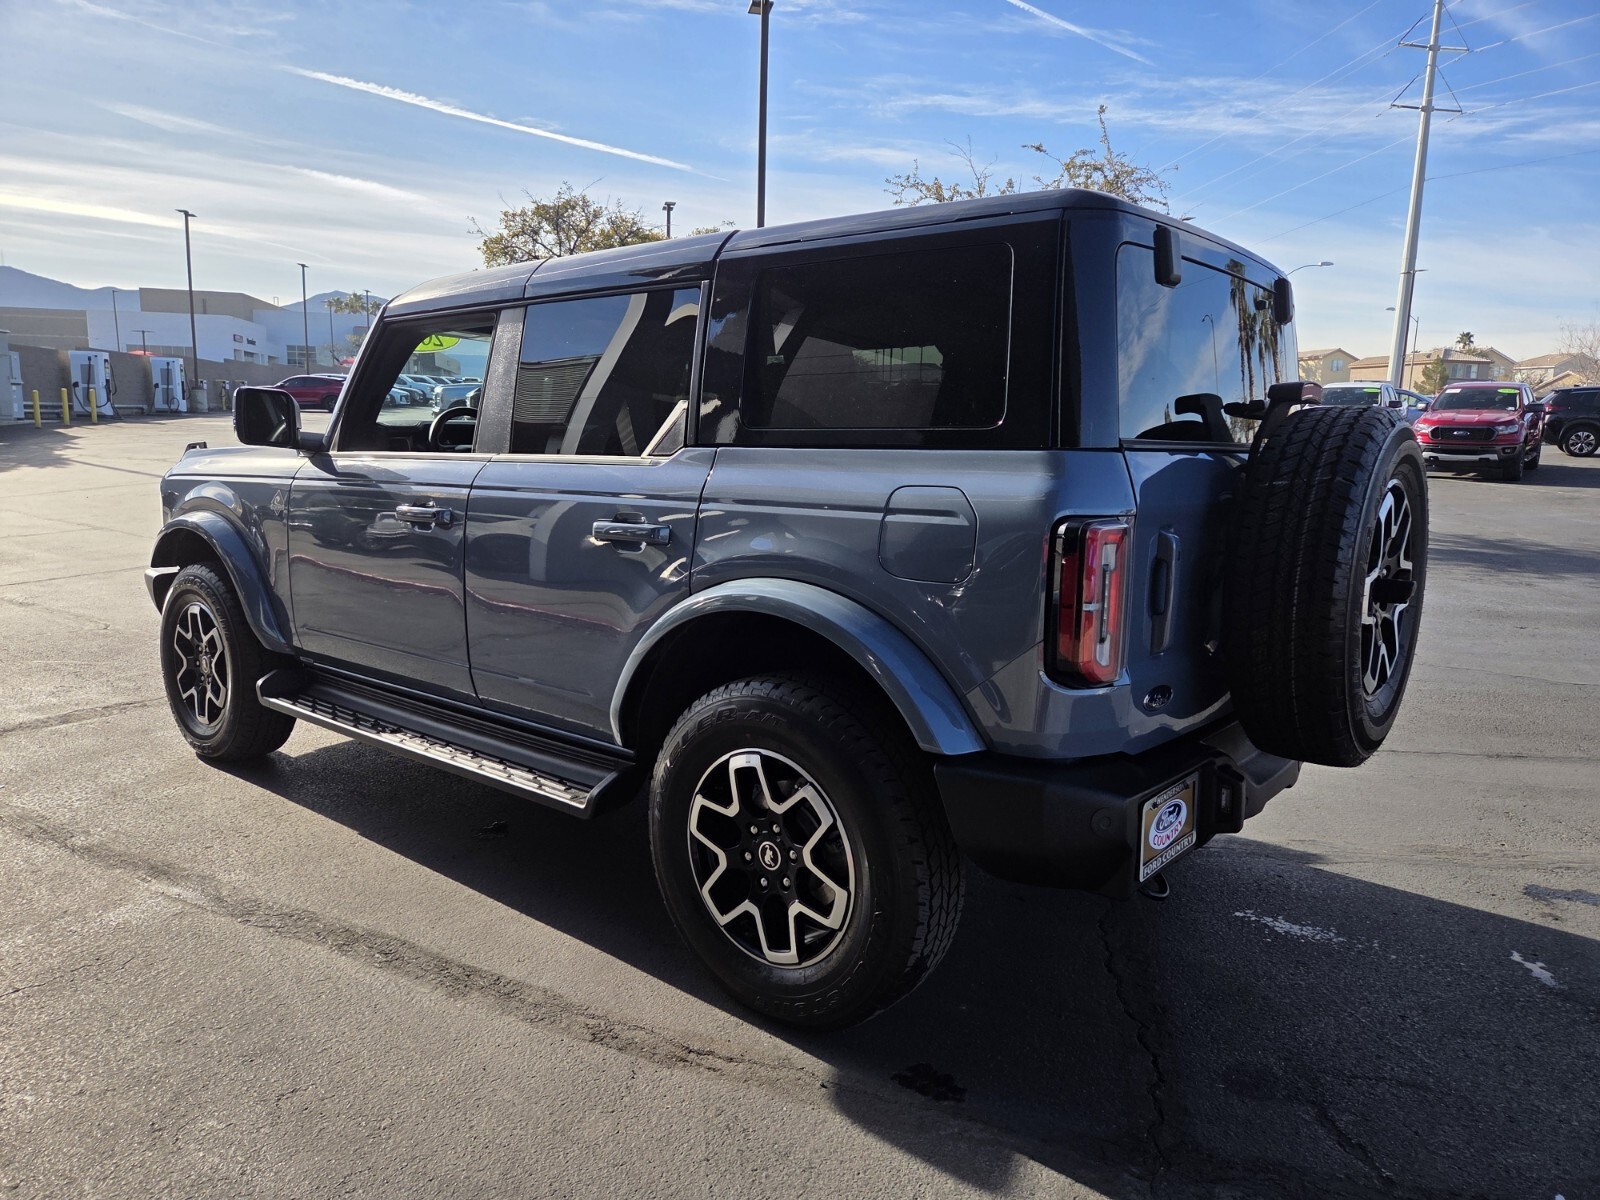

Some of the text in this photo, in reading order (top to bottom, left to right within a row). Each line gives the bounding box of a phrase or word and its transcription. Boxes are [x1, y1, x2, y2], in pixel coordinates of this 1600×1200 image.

[1153, 820, 1182, 846] COUNTRY
[1143, 834, 1193, 877] FORD COUNTRY
